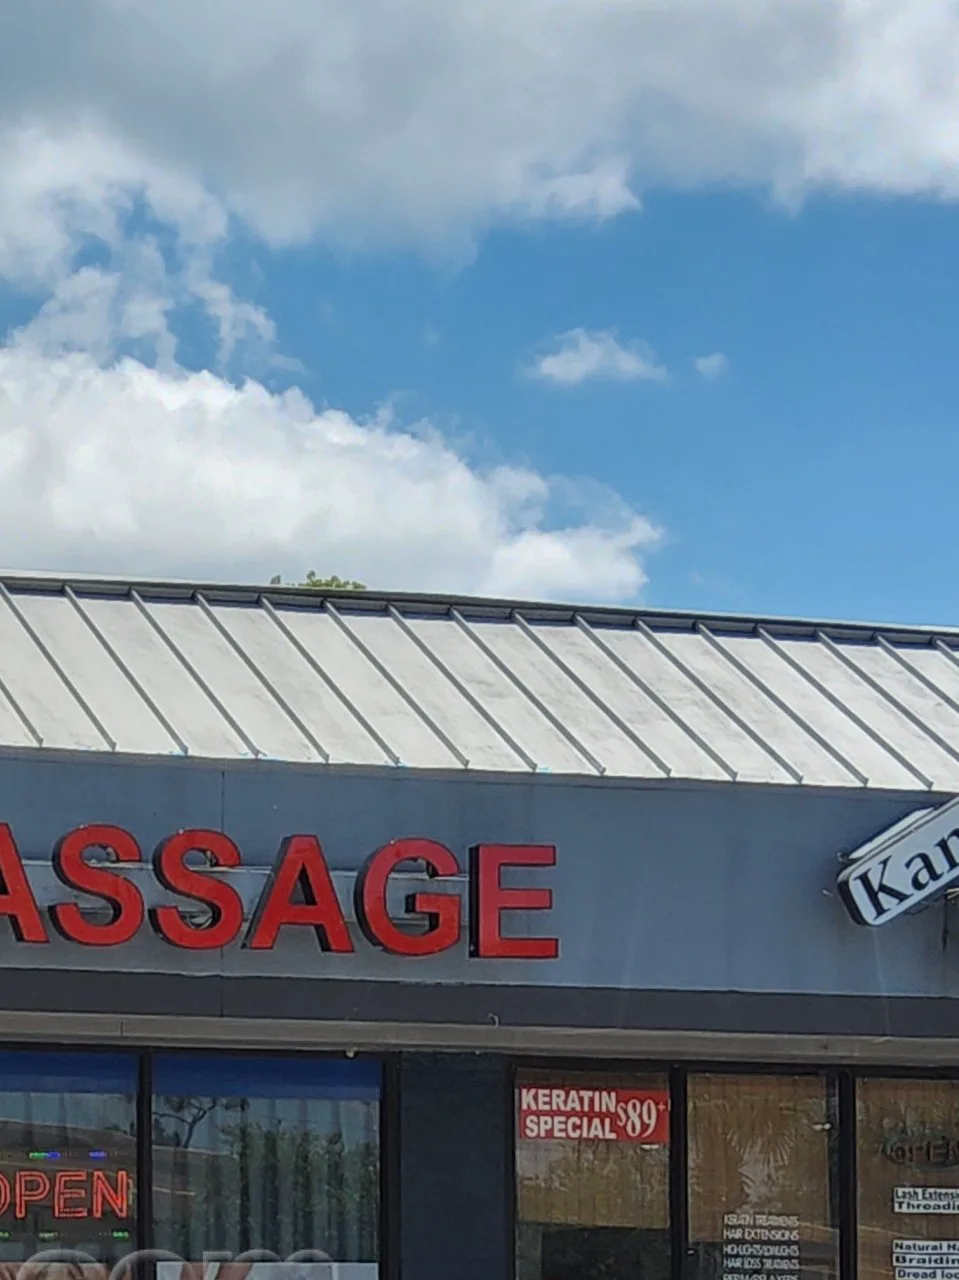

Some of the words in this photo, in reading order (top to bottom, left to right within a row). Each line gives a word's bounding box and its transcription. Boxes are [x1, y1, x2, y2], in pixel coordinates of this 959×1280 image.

[521, 1088, 616, 1113] KERATIN
[525, 1115, 617, 1139] SPECIAL
[895, 1189, 919, 1200] Lash
[896, 1201, 959, 1211] Threadi
[723, 1227, 743, 1240] HAIR
[744, 1228, 800, 1241] EXTENSIONS
[894, 1242, 943, 1251] Natural
[897, 1269, 936, 1280] Dread
